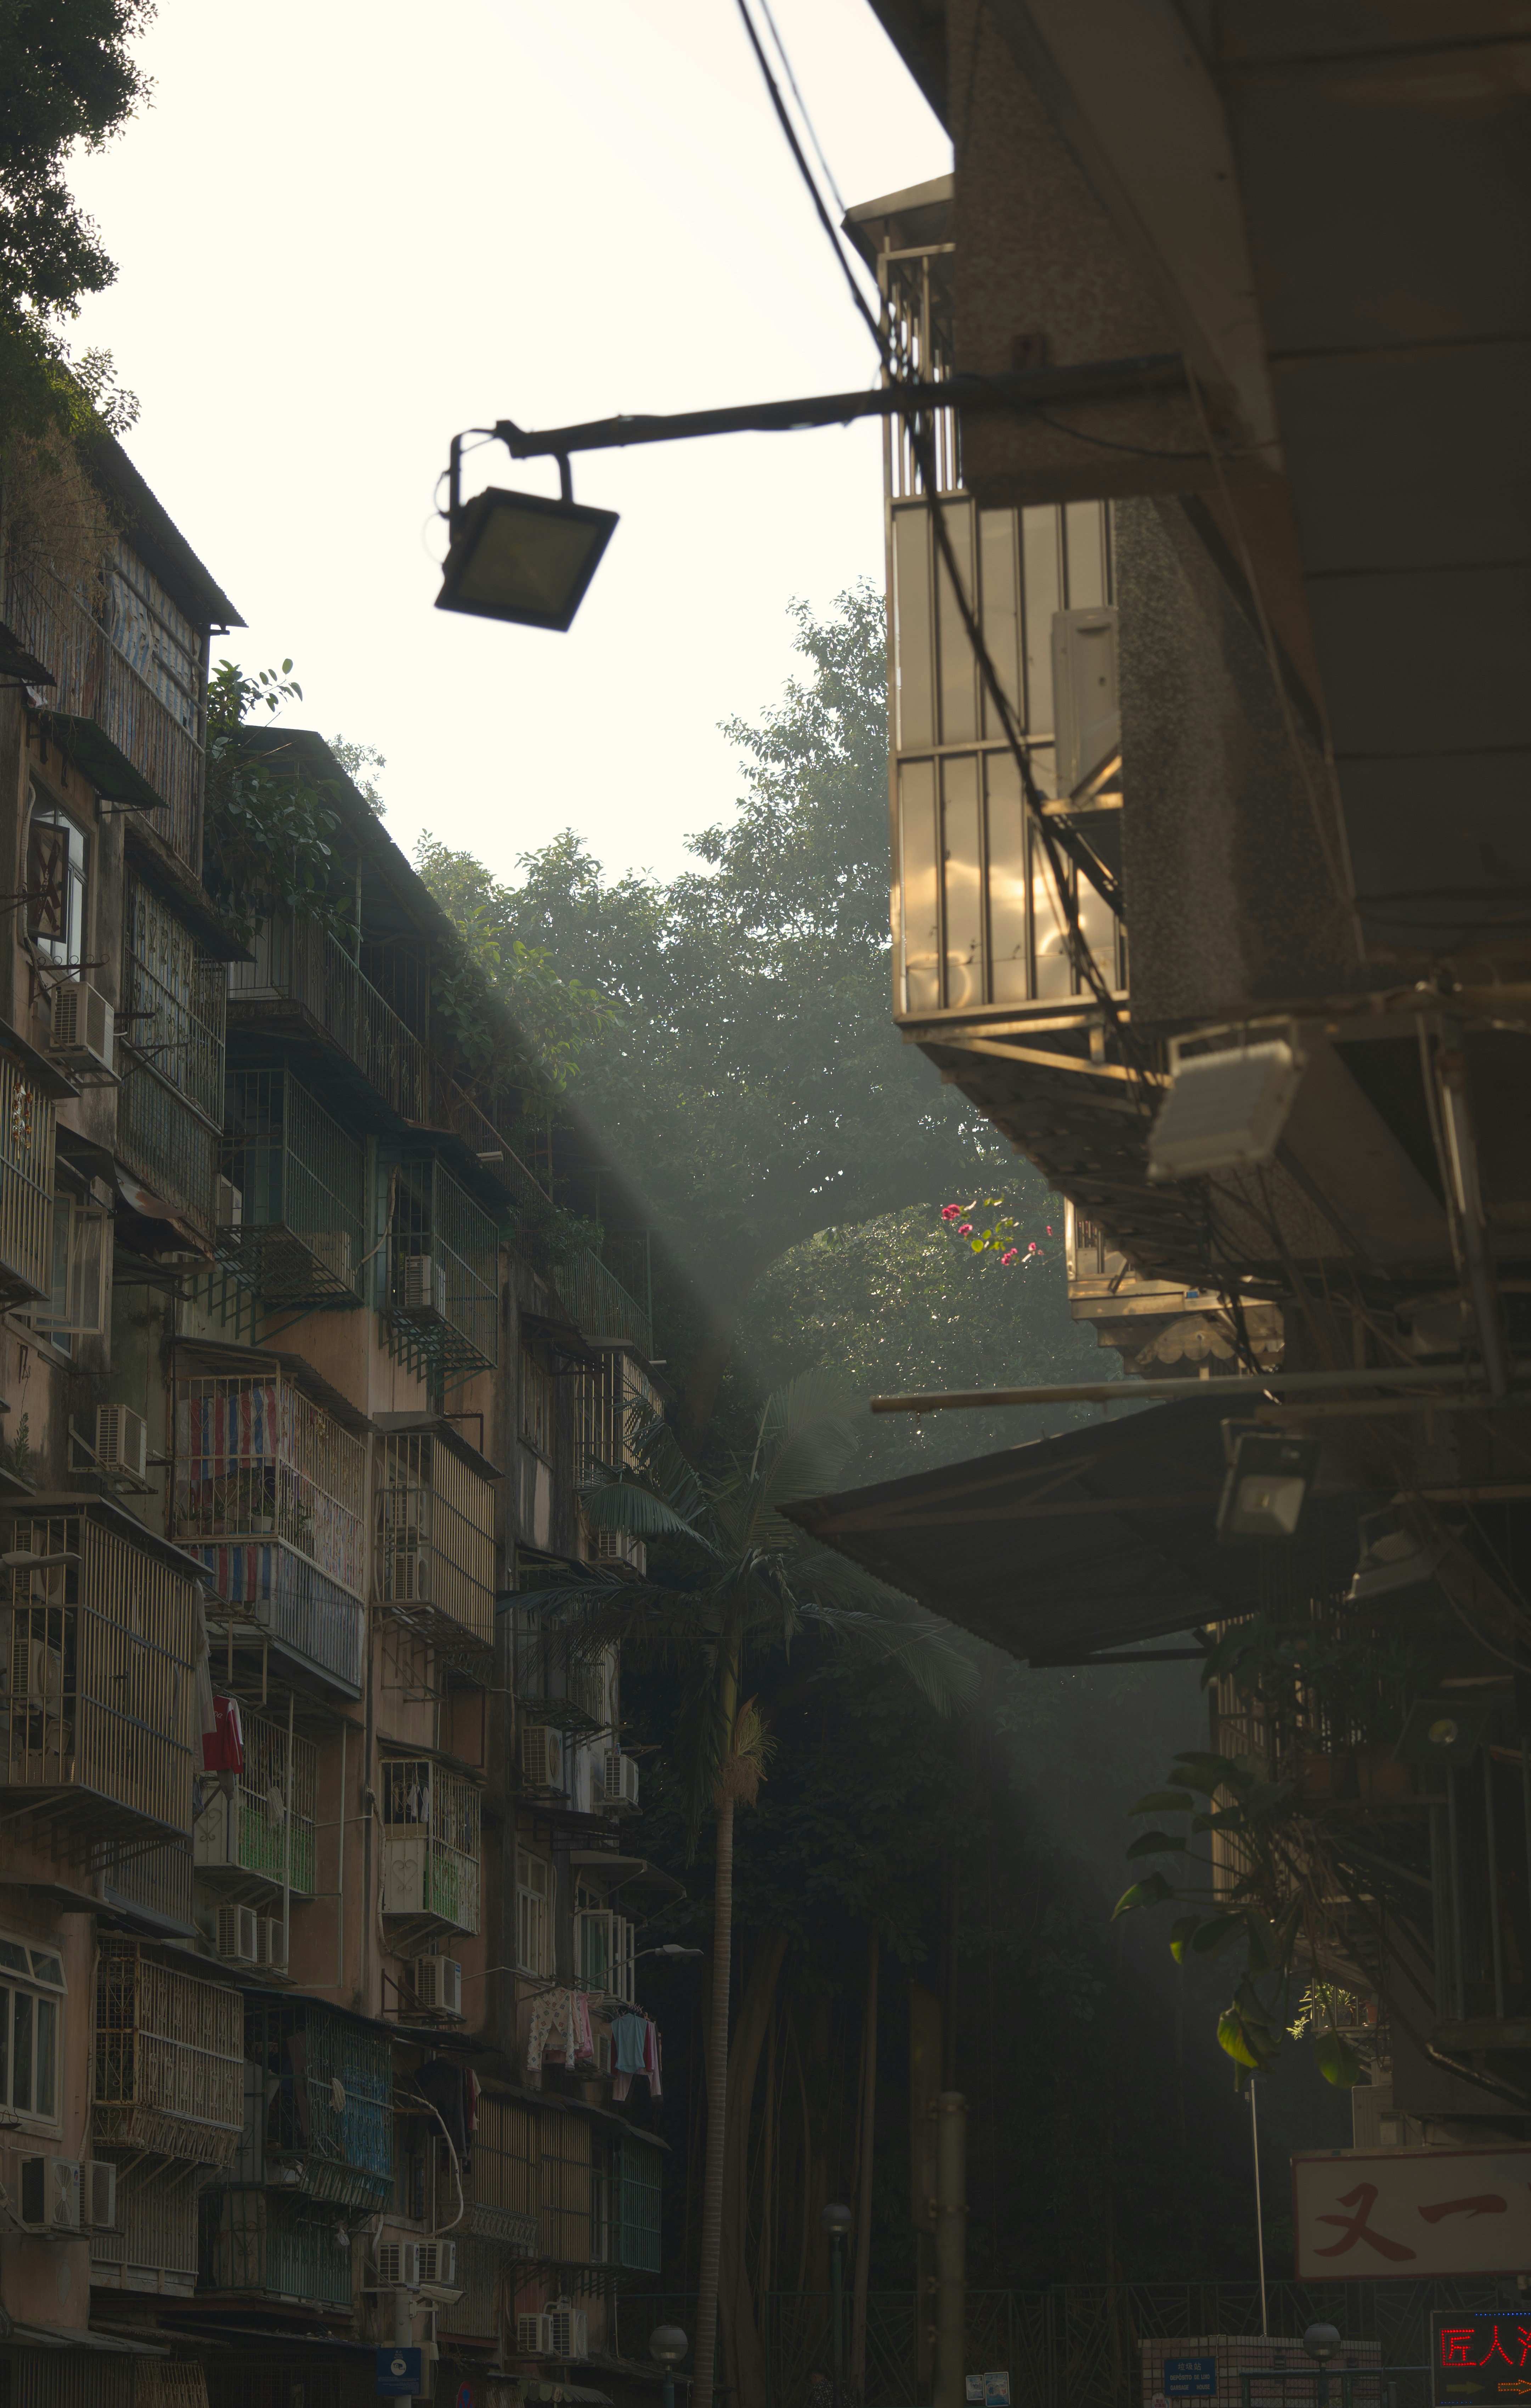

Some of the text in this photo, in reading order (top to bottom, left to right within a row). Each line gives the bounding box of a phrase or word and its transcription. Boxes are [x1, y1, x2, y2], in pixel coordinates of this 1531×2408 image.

[1313, 2182, 1531, 2262] 又一
[1178, 2362, 1201, 2370] 垃圾站
